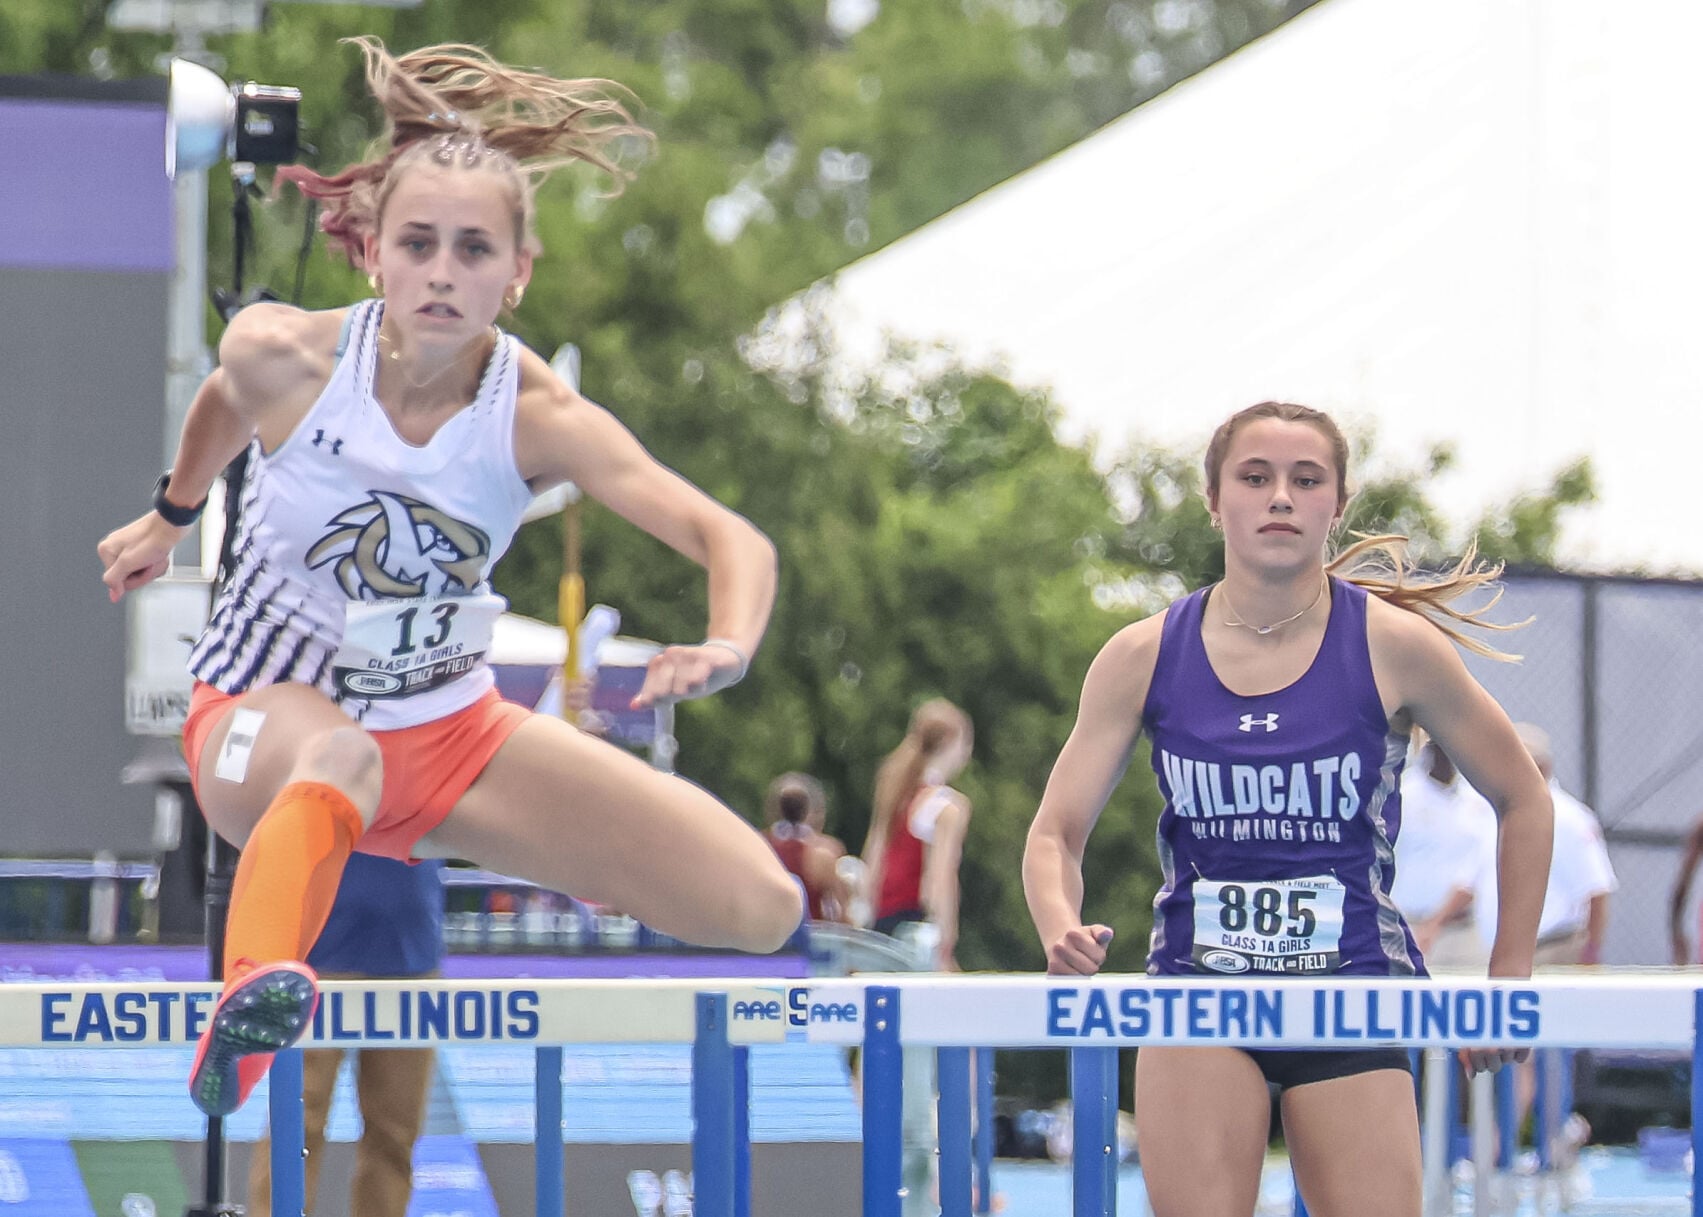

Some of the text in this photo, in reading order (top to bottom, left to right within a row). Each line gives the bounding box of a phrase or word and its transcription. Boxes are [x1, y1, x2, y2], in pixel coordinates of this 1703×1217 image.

[391, 602, 459, 656] 13
[368, 657, 409, 672] CLASS
[430, 643, 463, 661] GIRLS
[445, 655, 474, 675] FIELD
[1161, 749, 1361, 821] WILDCATS
[1218, 885, 1317, 937] 885
[1222, 934, 1311, 953] CLASS 1A GIRLS
[1253, 956, 1285, 971] TRACK
[1299, 954, 1327, 970] FIELD
[41, 991, 539, 1041] EASTE ILLINOIS
[1047, 988, 1540, 1039] EASTERN ILLINOIS
